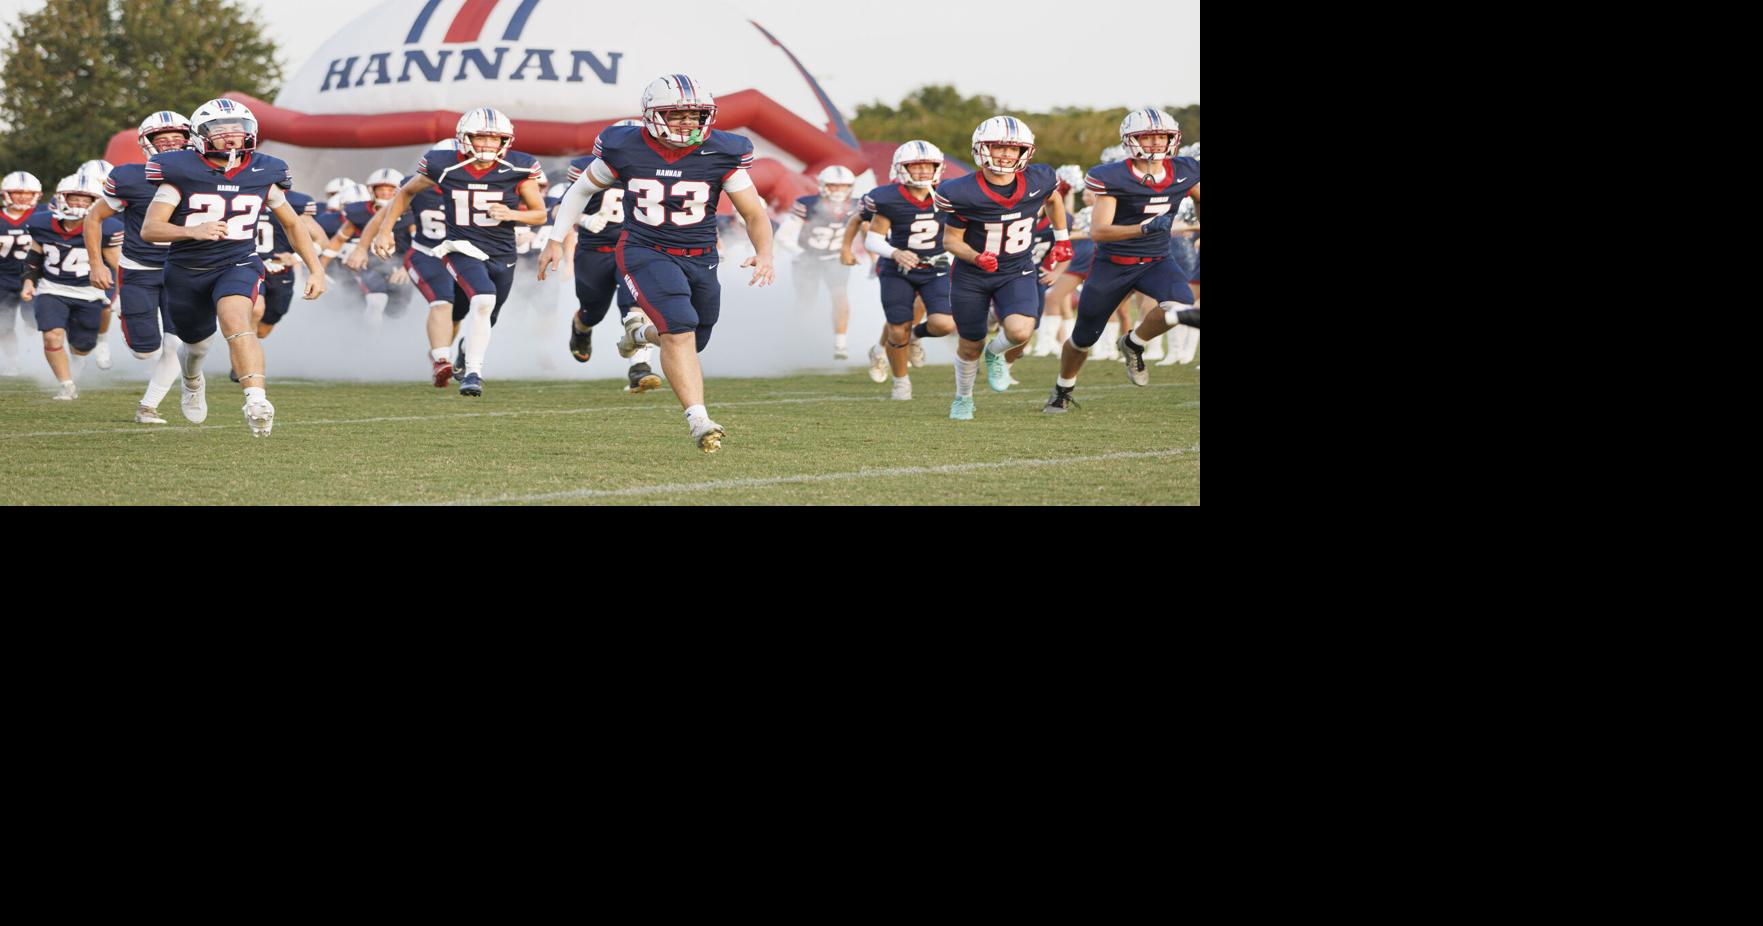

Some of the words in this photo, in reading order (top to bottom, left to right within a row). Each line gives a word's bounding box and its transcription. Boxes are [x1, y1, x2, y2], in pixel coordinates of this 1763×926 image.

[320, 47, 623, 92] HANNAN
[656, 168, 683, 178] HANNAN
[184, 193, 263, 240] 22
[451, 189, 504, 227] 15
[627, 177, 711, 227] 33
[907, 219, 940, 250] 2
[984, 216, 1035, 256] 18
[42, 242, 91, 278] 24
